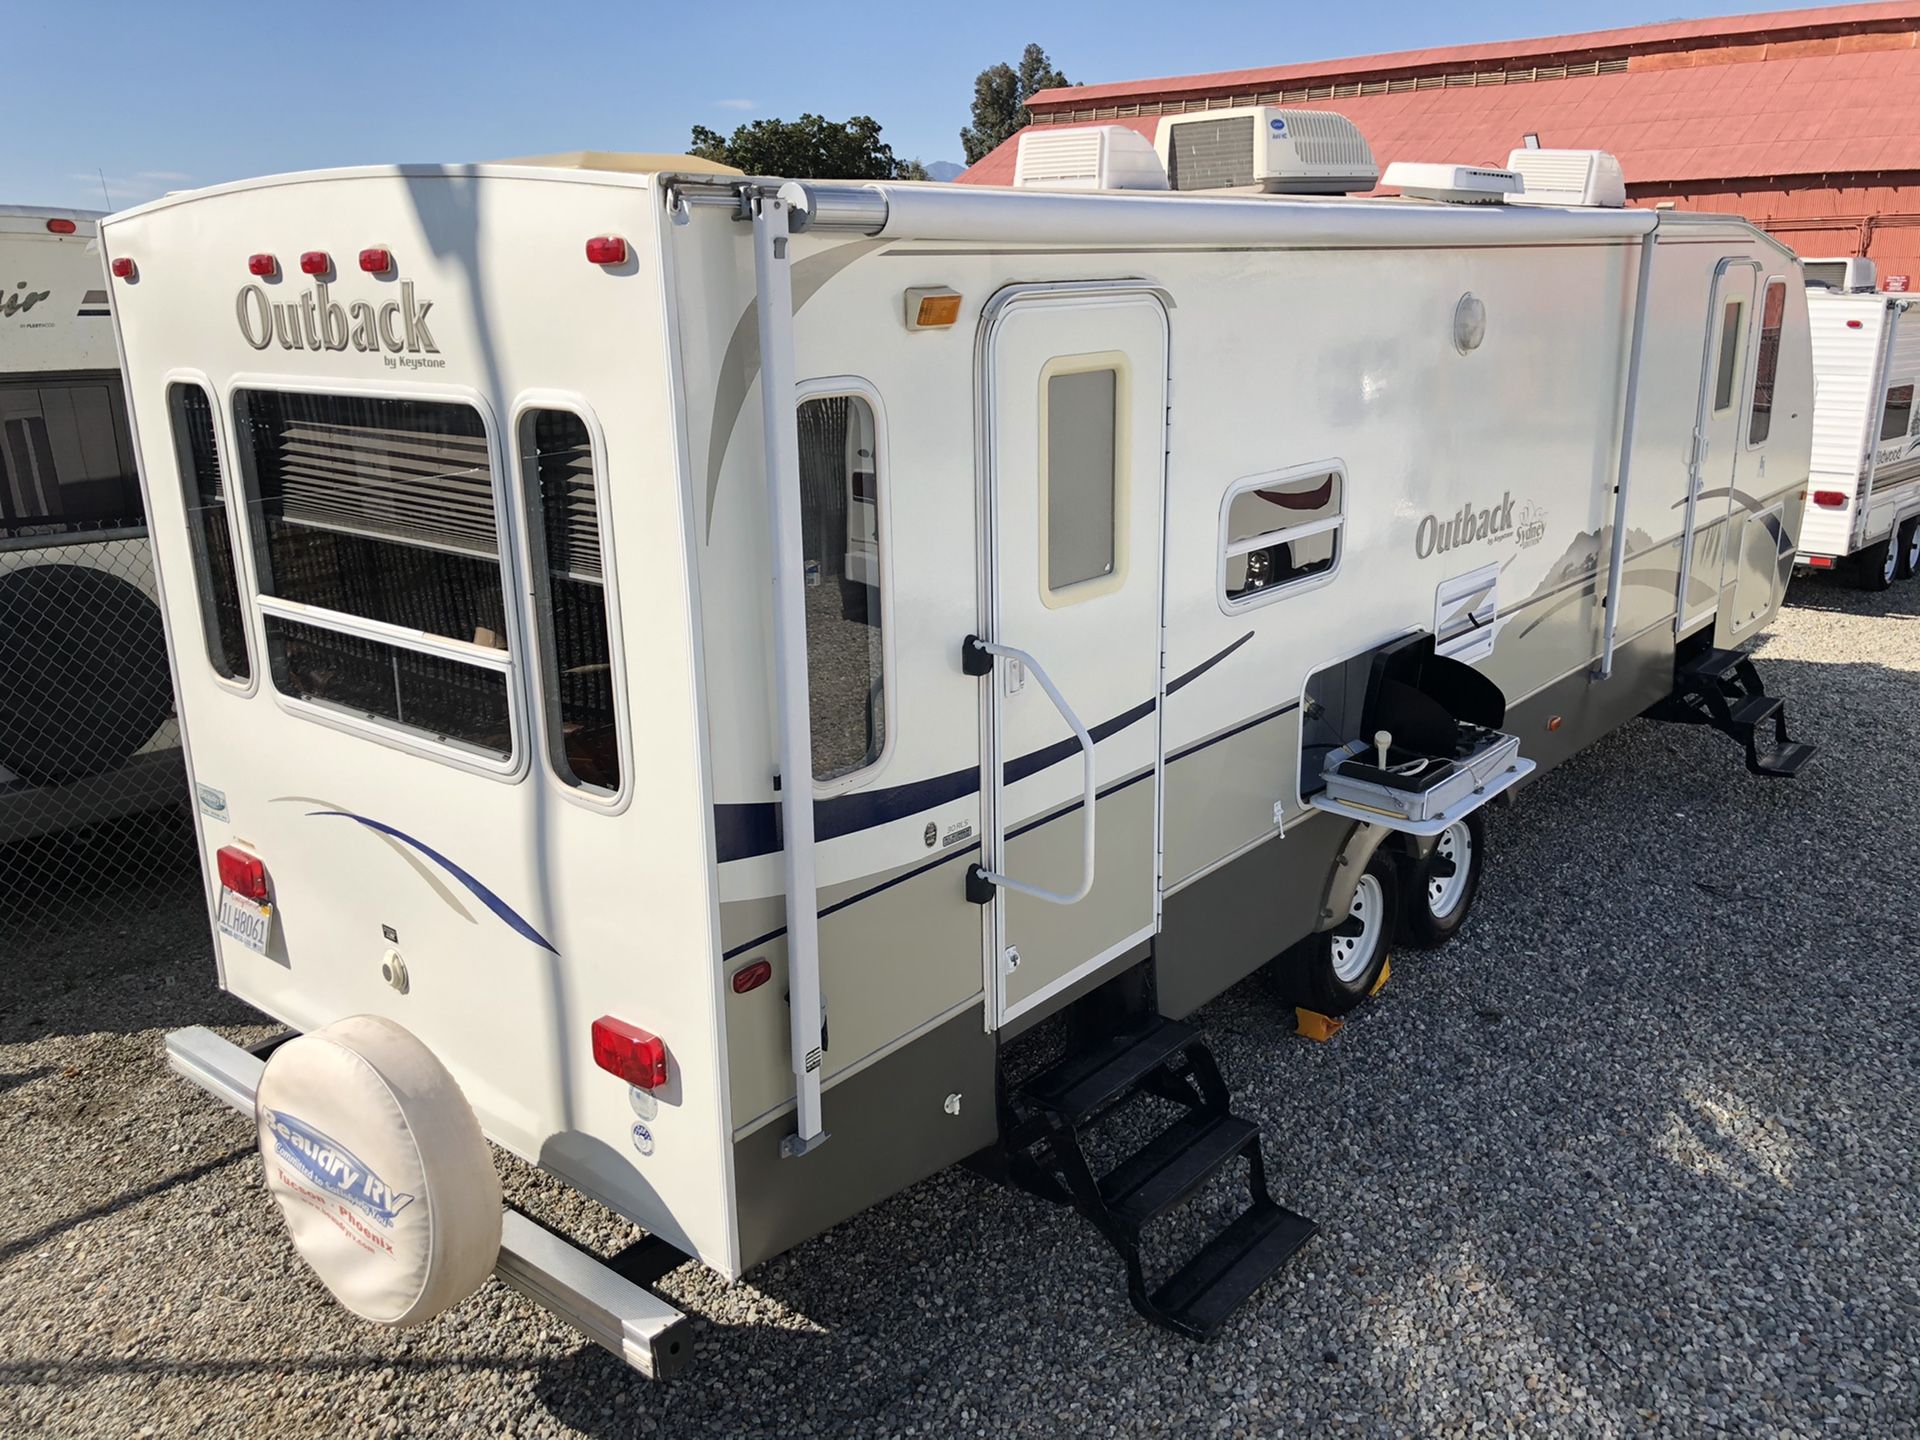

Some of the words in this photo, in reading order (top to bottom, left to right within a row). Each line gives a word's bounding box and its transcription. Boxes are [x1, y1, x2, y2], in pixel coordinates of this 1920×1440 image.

[236, 278, 440, 353] Outback
[384, 356, 397, 369] by
[399, 356, 445, 369] Keystone
[1415, 491, 1515, 559] Outback
[220, 902, 265, 944] 1LH8061
[262, 1105, 359, 1189] Beaudry
[362, 1173, 415, 1217] RV
[275, 1141, 314, 1181] Committed
[277, 1168, 327, 1204] Tucson
[338, 1203, 394, 1255] Phoenix
